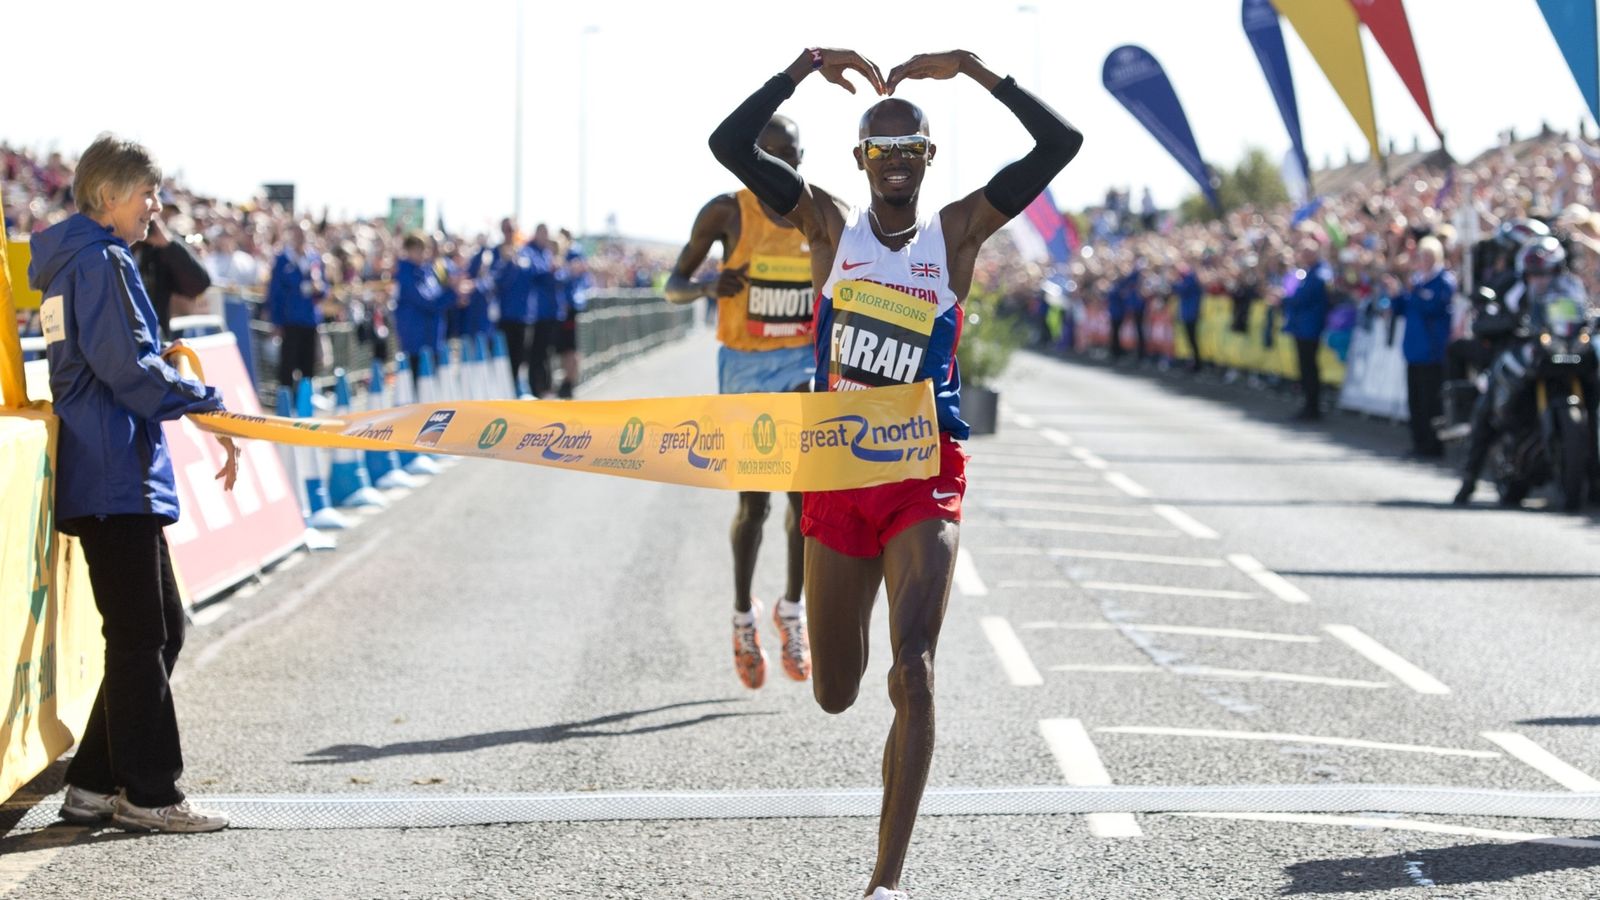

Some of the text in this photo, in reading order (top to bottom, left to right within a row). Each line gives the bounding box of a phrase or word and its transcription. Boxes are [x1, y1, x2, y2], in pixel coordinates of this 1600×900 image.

[855, 291, 927, 322] MORRISONS
[830, 321, 924, 384] FARAH
[515, 429, 593, 450] great north
[658, 427, 725, 455] great north
[800, 414, 934, 453] great north
[708, 457, 728, 472] run
[736, 460, 792, 475] MORRISONS
